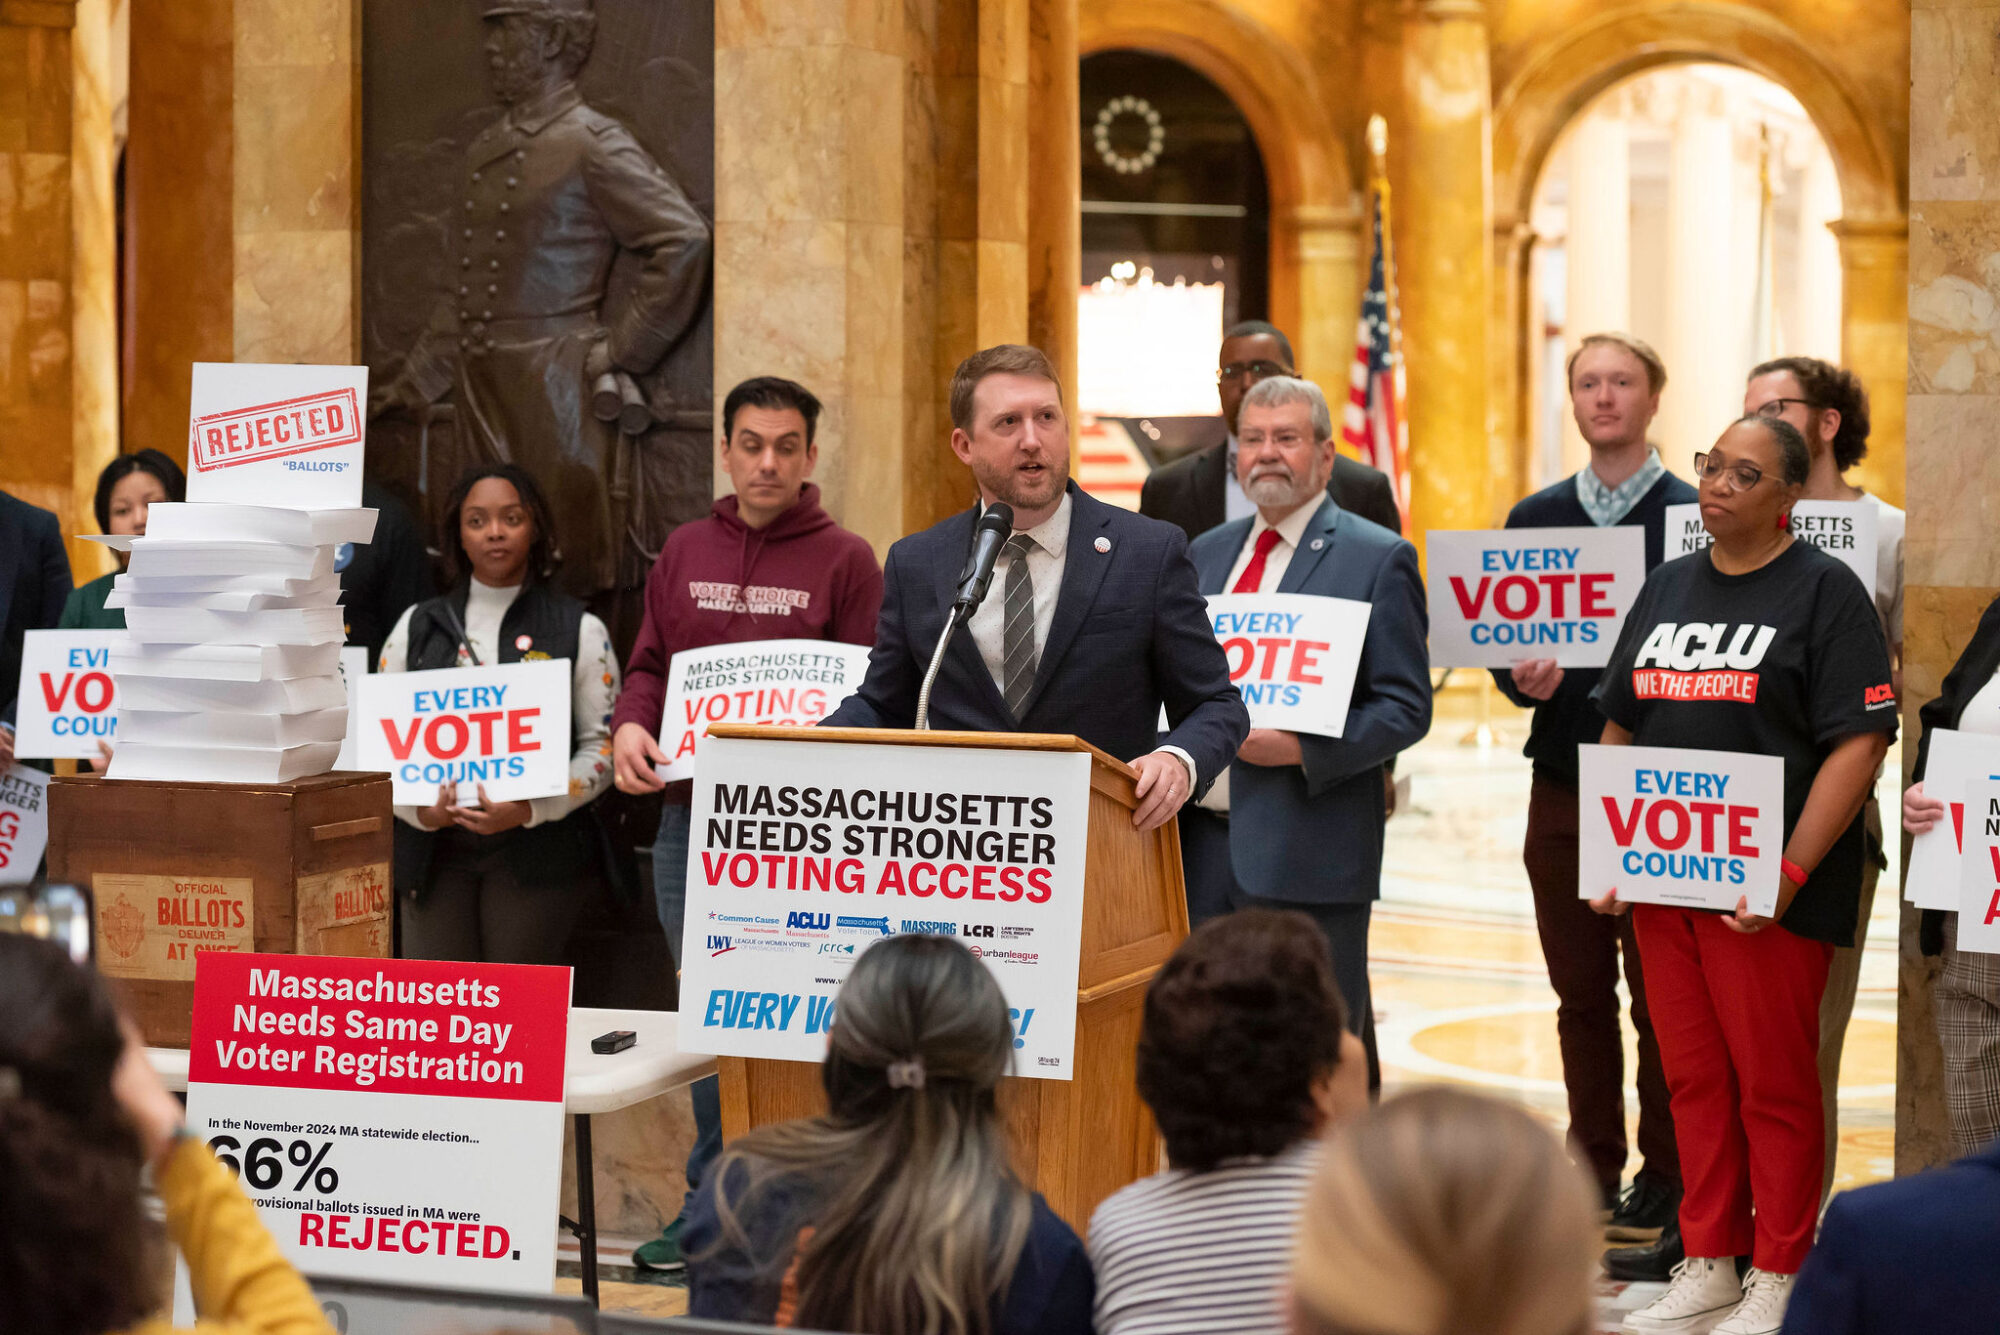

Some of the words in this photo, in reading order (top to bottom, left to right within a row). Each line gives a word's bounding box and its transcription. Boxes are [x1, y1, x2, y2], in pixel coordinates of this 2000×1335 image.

[207, 404, 345, 457] REJECTED
[1482, 547, 1580, 571] EVERY
[1449, 573, 1616, 620] VOTE
[1214, 613, 1303, 634] EVERY
[1470, 621, 1599, 645] COUNTS
[1634, 623, 1777, 671] ACLU
[683, 672, 737, 692] NEEDS
[741, 667, 845, 685] STRONGER
[687, 654, 845, 677] MASSACHUSETTS
[414, 684, 508, 712] EVERY
[1635, 674, 1658, 697] WE
[1659, 673, 1693, 698] THE
[1693, 673, 1754, 699] PEOPLE
[685, 688, 827, 725] VOTING
[380, 708, 541, 760] VOTE
[400, 756, 525, 784] COUNTS
[1635, 769, 1730, 798] EVERY
[713, 783, 1054, 829] MASSACHUSETTS
[1601, 796, 1759, 858] VOTE
[706, 818, 832, 854] NEEDS
[842, 824, 1056, 865] STRONGER
[701, 851, 865, 894] VOTING
[875, 860, 1053, 904] ACCESS
[1622, 850, 1745, 884] COUNTS
[175, 883, 227, 895] OFFICIAL
[157, 897, 245, 928] BALLOTS
[718, 914, 753, 923] Common
[755, 916, 780, 924] Cause
[786, 911, 831, 930] ACLU
[837, 918, 884, 927] Massachusetts
[178, 929, 226, 941] DELIVER
[901, 920, 957, 936] MASSPIRG
[963, 925, 995, 938] LCR
[167, 942, 188, 961] AT
[707, 935, 733, 950] LWV
[248, 968, 500, 1008] Massachusetts
[704, 989, 801, 1031] EVERY
[233, 1004, 335, 1038] Needs
[344, 1009, 438, 1042] Same
[448, 1014, 513, 1055] Day
[216, 1040, 305, 1072] Voter
[314, 1045, 524, 1086] Registration
[208, 1118, 220, 1128] In
[222, 1118, 241, 1130] the
[243, 1119, 304, 1134] November
[306, 1123, 337, 1135] 2024
[339, 1125, 359, 1137] MA
[361, 1126, 419, 1141] statewide
[316, 1199, 360, 1214] ballots
[362, 1202, 404, 1218] issued
[406, 1205, 420, 1218] in
[422, 1206, 444, 1221] MA
[447, 1210, 481, 1223] were
[299, 1212, 520, 1261] REJECTED.
